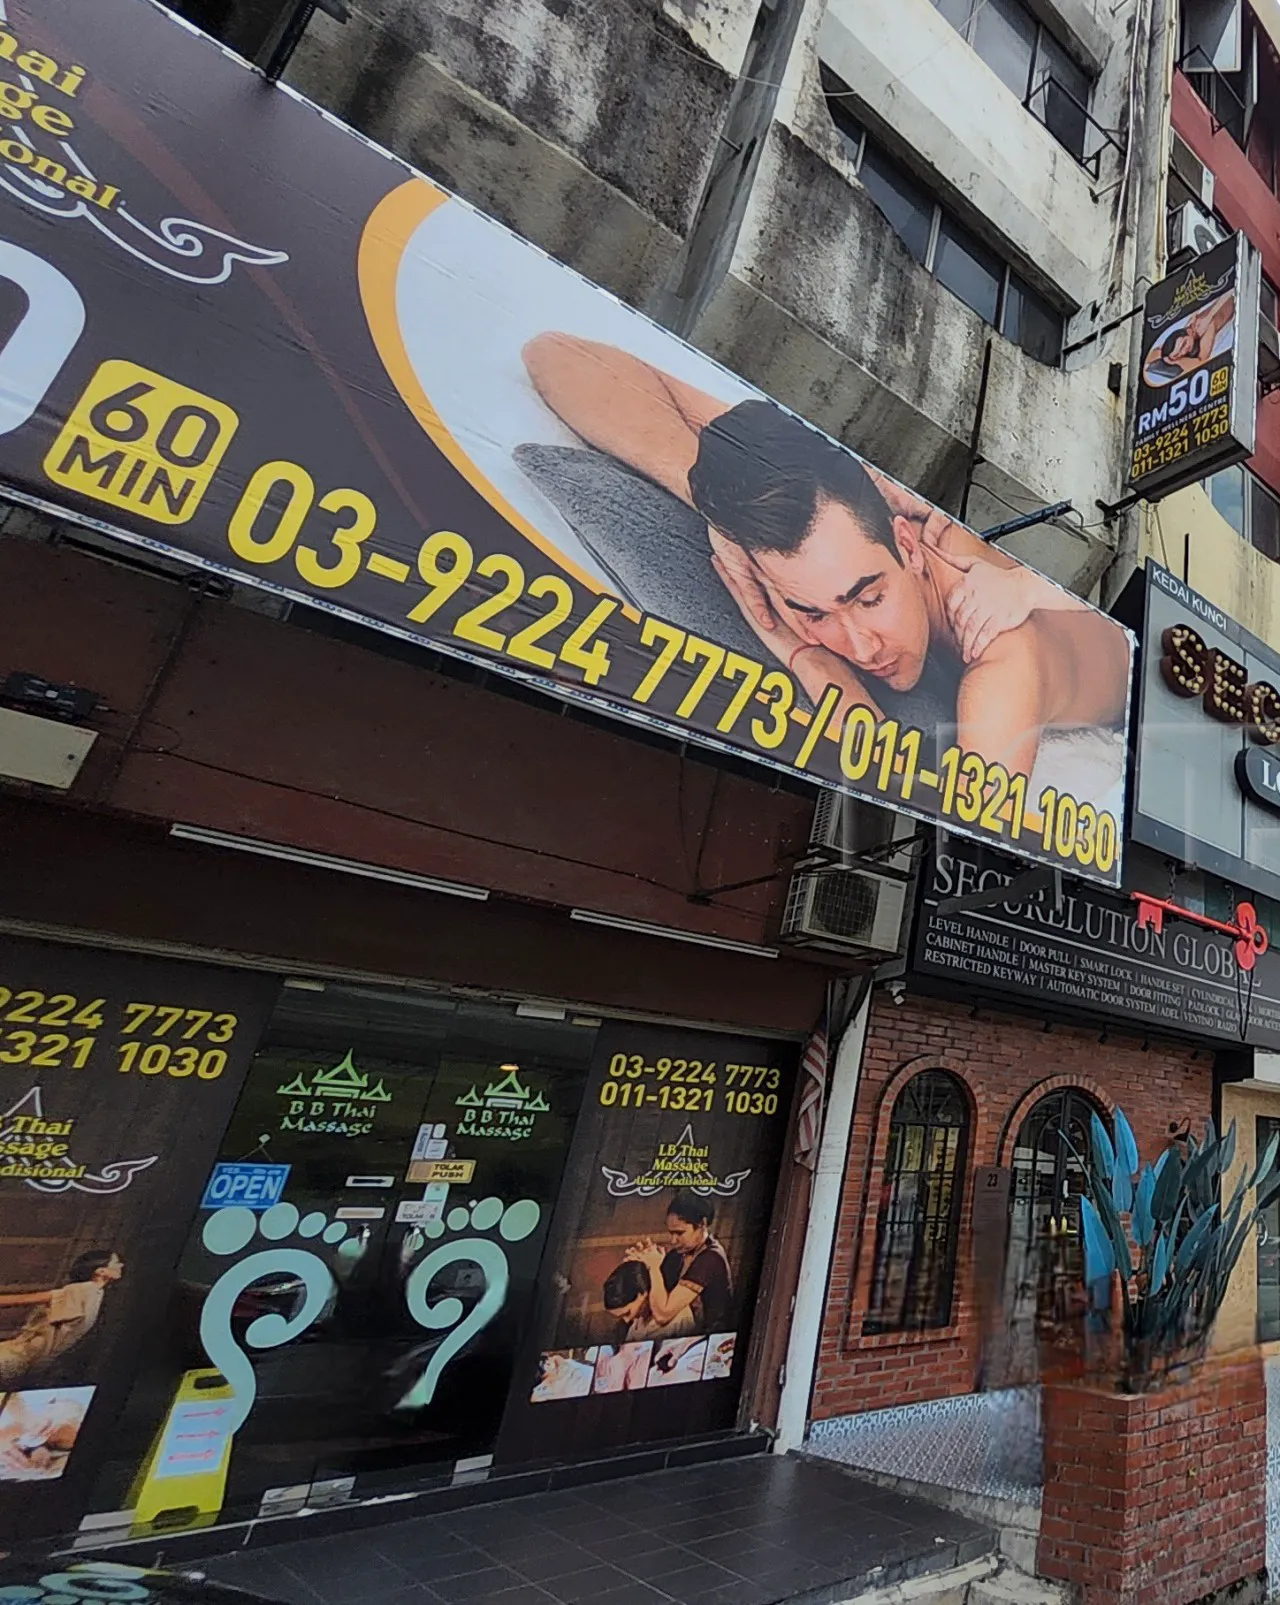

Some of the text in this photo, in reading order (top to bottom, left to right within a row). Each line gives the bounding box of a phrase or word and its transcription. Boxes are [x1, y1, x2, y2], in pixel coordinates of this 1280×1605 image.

[1212, 367, 1227, 386] 60
[1138, 369, 1209, 434] RM50
[1162, 411, 1197, 433] WELLNESS
[1199, 395, 1227, 414] CENTRE
[89, 381, 222, 469] 60
[1133, 404, 1228, 462] 03-9224 7773
[1131, 419, 1229, 478] 011-1321 1030
[56, 435, 196, 517] MIN
[1152, 566, 1227, 631] KEDAI KUNCI
[227, 461, 611, 685] 03-9224
[840, 706, 1026, 840] 011-1321
[1041, 788, 1117, 873] 1030
[926, 932, 976, 955] CABINET
[976, 945, 1020, 966] HANDLE
[1028, 958, 1067, 978] MASTER
[1068, 968, 1087, 983] KEY
[1087, 974, 1120, 991] SYSTEM
[1129, 984, 1152, 999] DOOR
[1153, 991, 1181, 1006] FITTING
[928, 915, 964, 936] LEVEL
[966, 926, 1009, 948] HANDLE
[1019, 940, 1047, 958] DOOR
[1048, 948, 1071, 965] PULL
[1080, 958, 1109, 974] SMART
[1111, 966, 1133, 981] LOCK
[1140, 974, 1171, 991] HANDLE
[1172, 983, 1185, 995] SET
[1173, 933, 1262, 988] GLOB
[924, 948, 992, 975] RESTRICTED
[993, 964, 1037, 986] KEYWAY
[1046, 979, 1100, 1001] AUTOMATIC
[1101, 992, 1124, 1007] DOOR
[1125, 999, 1156, 1014] SYSTEM
[120, 1002, 238, 1043] 7773
[0, 1029, 228, 1080] 321 1030
[609, 1053, 781, 1090] 03-9224 7773
[289, 1100, 377, 1119] B B Thai
[464, 1108, 536, 1126] B B Thai
[600, 1081, 778, 1115] 011-1321 1030
[12, 1115, 75, 1136] Thai
[280, 1115, 374, 1137] Massage
[456, 1122, 532, 1141] Massage
[434, 1163, 464, 1171] TOLAK
[652, 1157, 709, 1174] Massage
[658, 1143, 709, 1157] LB Thai
[211, 1174, 282, 1200] OPEN
[987, 1173, 998, 1188] 23
